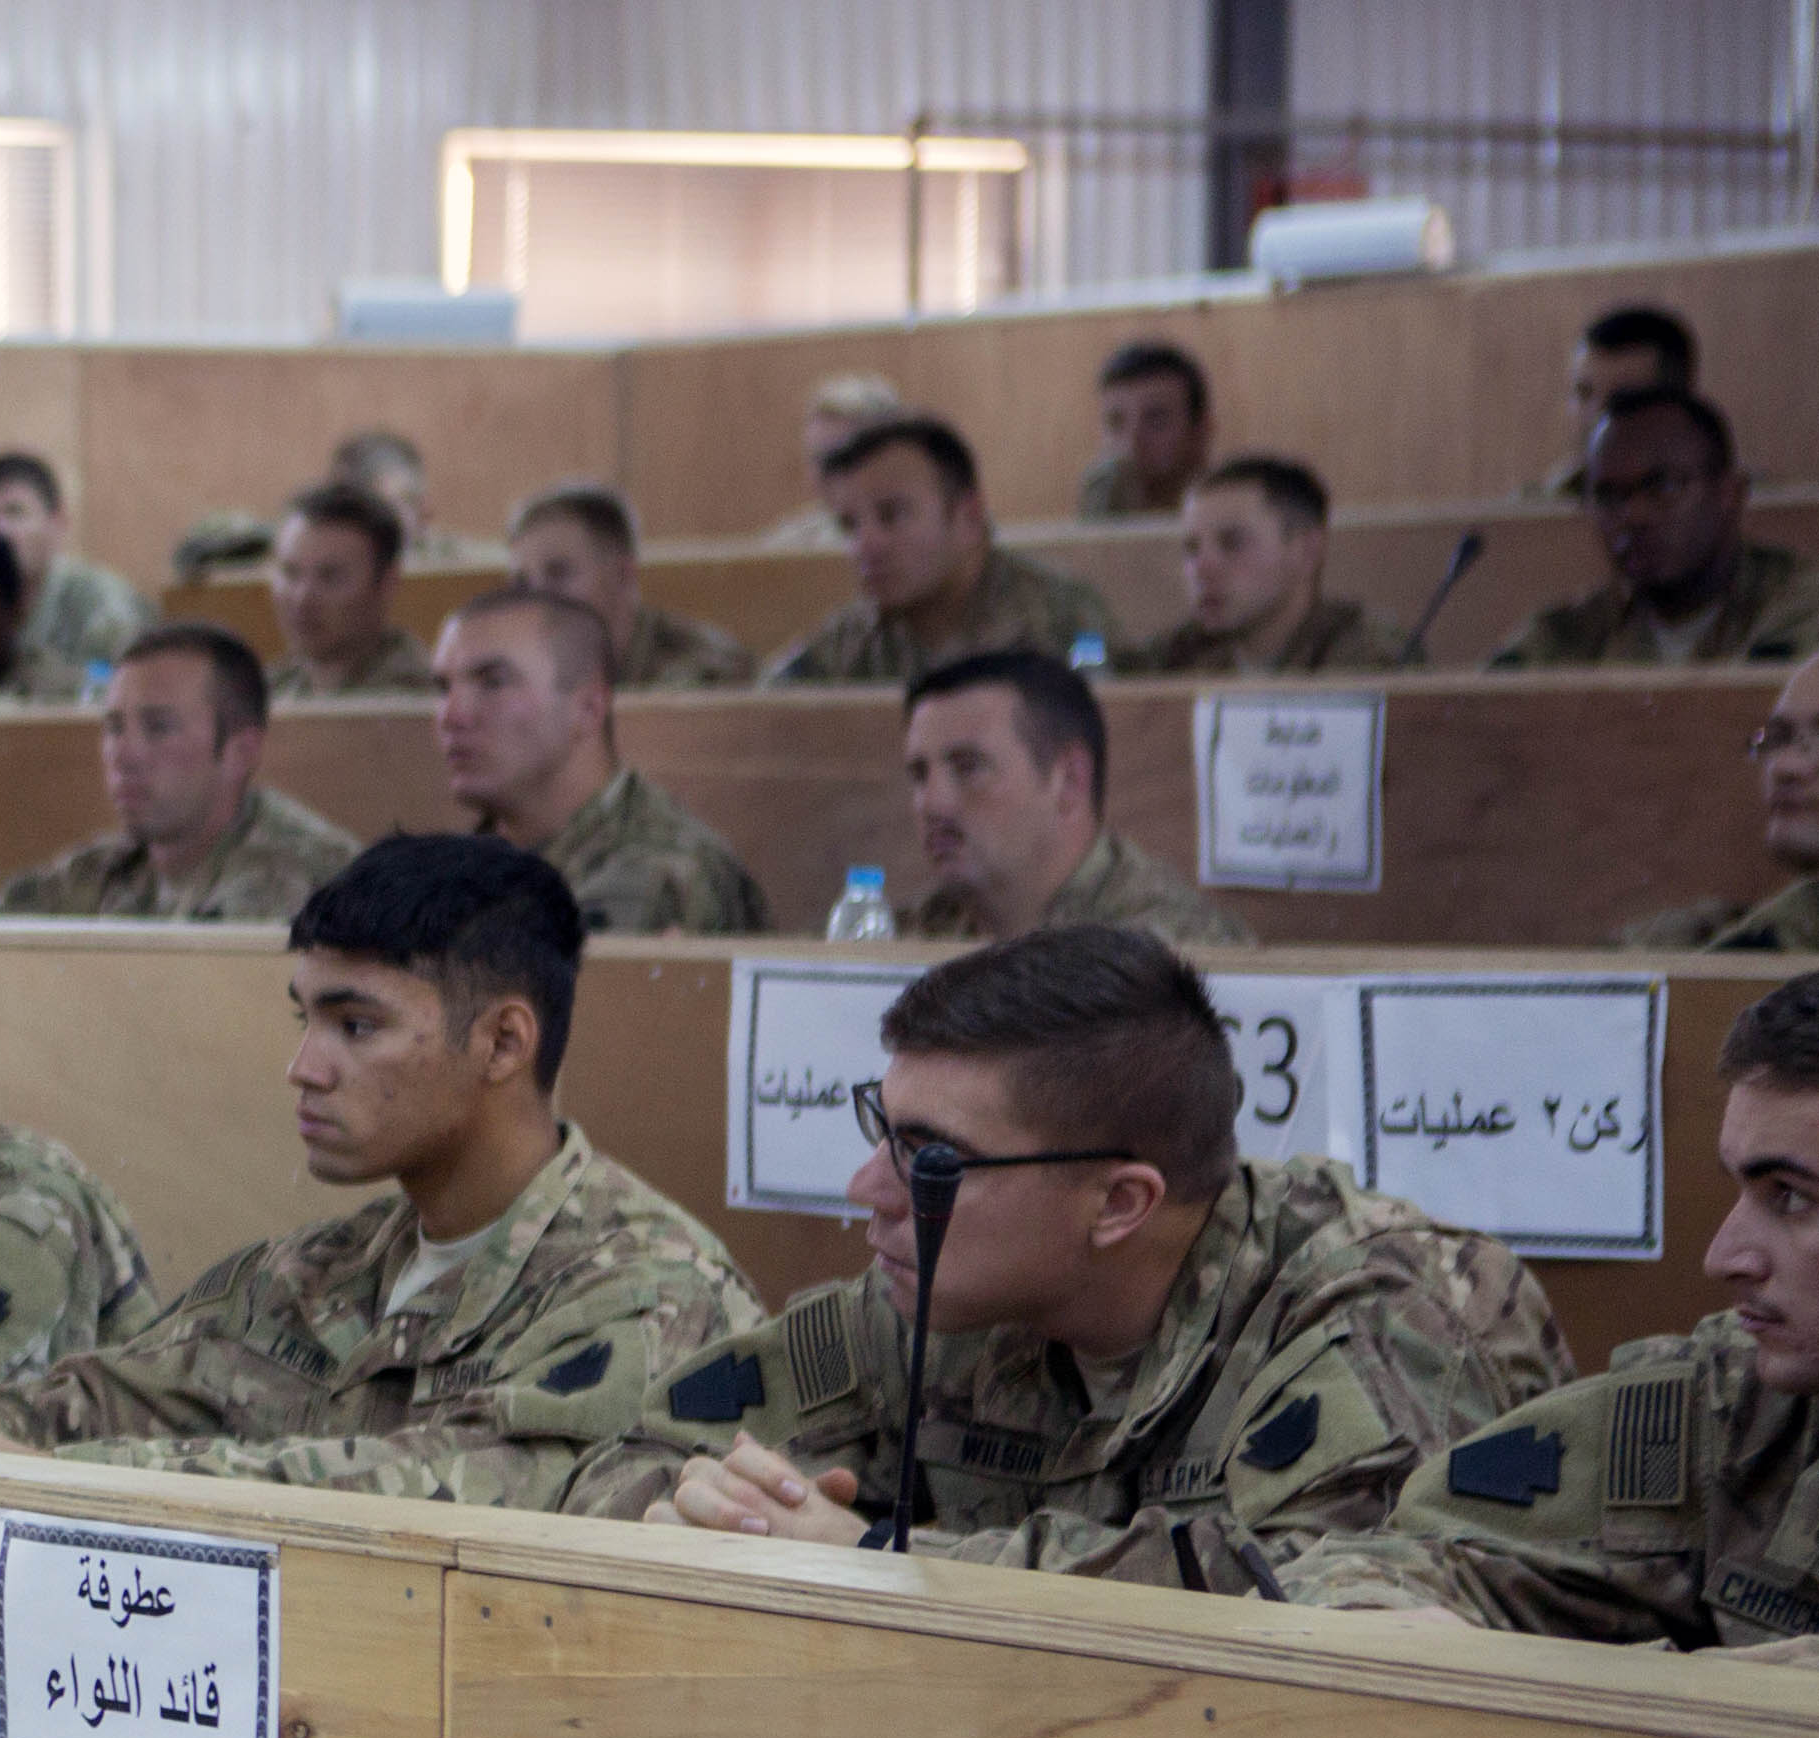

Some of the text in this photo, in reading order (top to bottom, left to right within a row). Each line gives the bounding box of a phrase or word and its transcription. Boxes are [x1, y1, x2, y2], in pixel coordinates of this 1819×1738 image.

[757, 1066, 848, 1121] عمليات
[1379, 1091, 1516, 1151] عمليات
[76, 1555, 176, 1628] عطوفة
[46, 1655, 221, 1729] قائد اللواء
